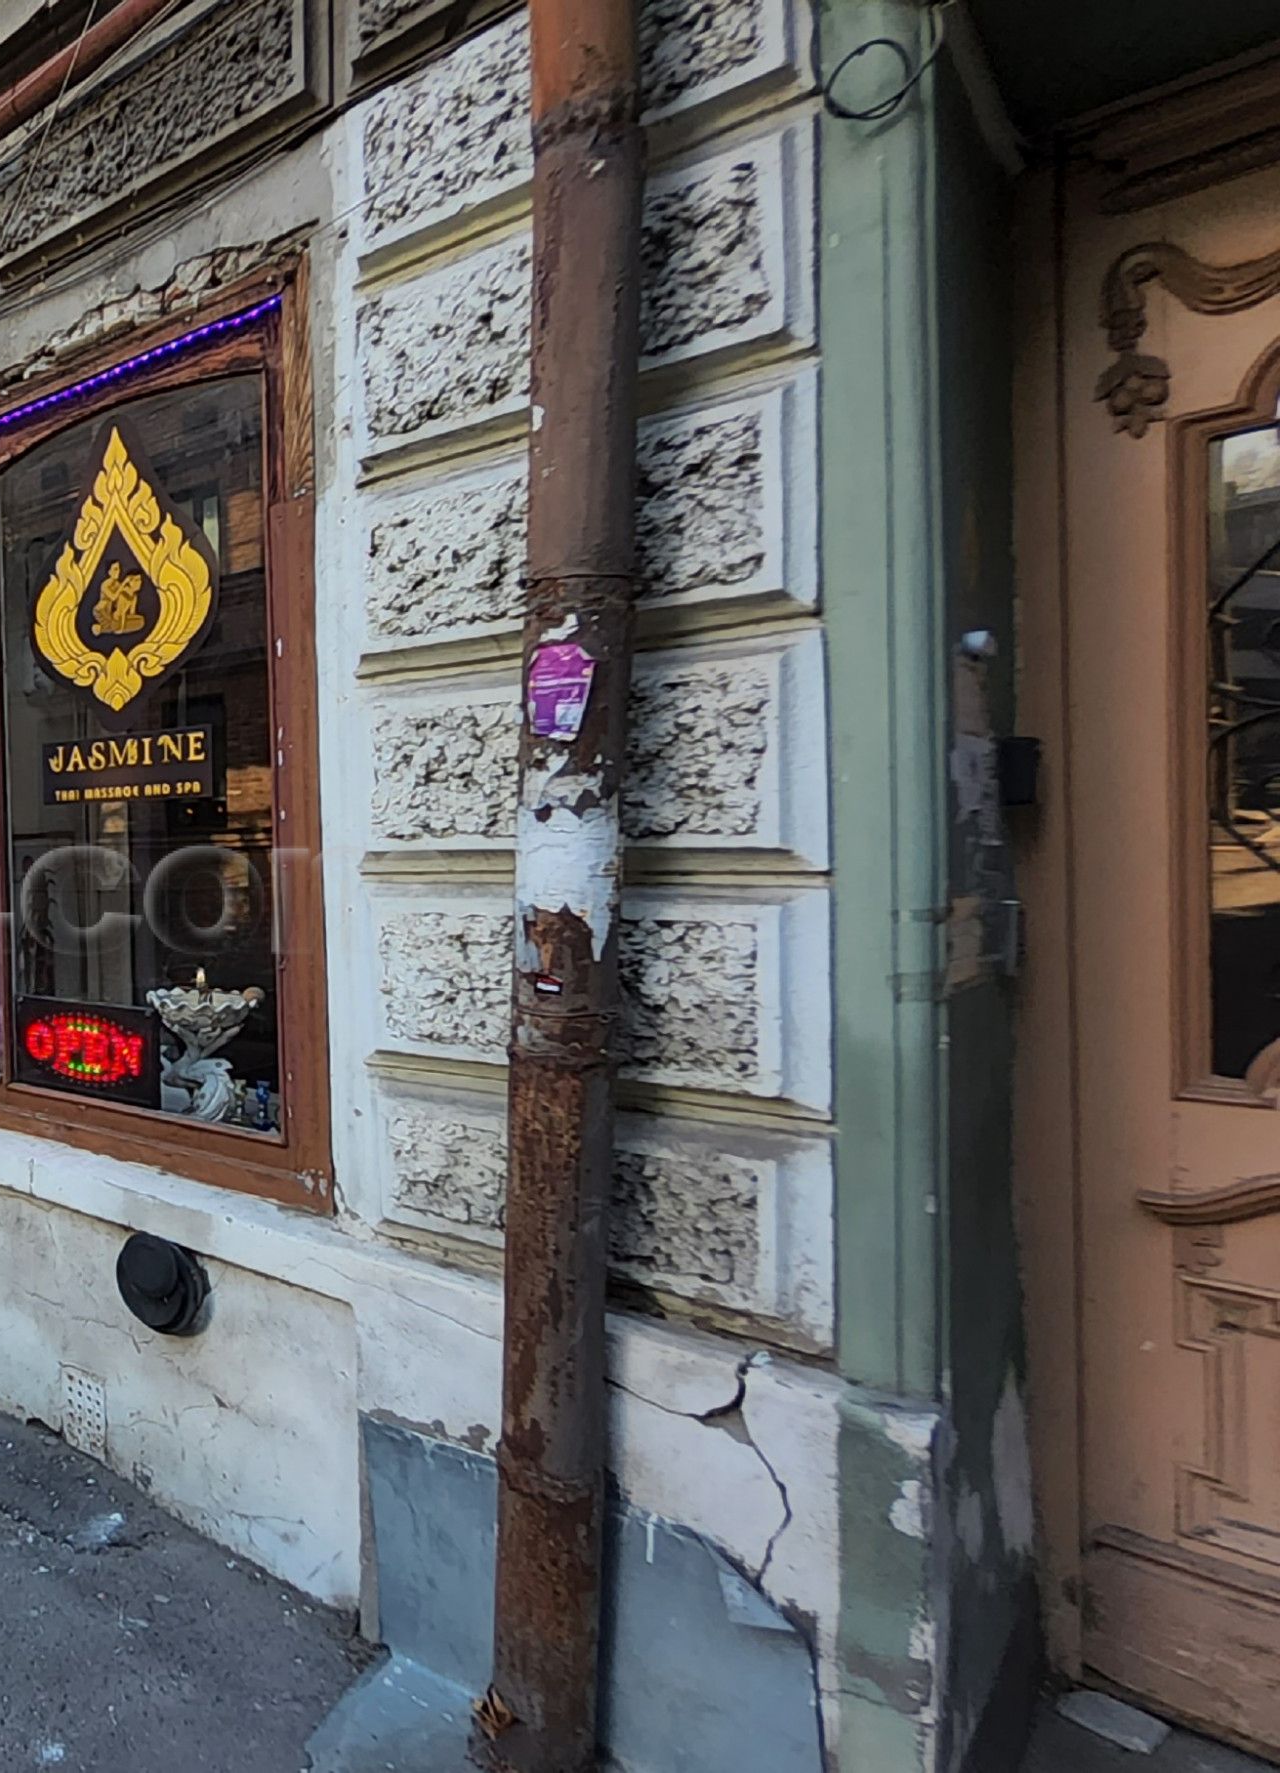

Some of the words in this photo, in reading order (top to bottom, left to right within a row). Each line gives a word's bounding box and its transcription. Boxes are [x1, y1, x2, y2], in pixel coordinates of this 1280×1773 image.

[48, 731, 205, 773] JASMINE
[55, 789, 80, 801] THAI
[84, 785, 140, 799] MASSAGE
[144, 783, 171, 796] AND
[176, 781, 201, 794] SPA
[24, 1019, 143, 1078] OPEN
